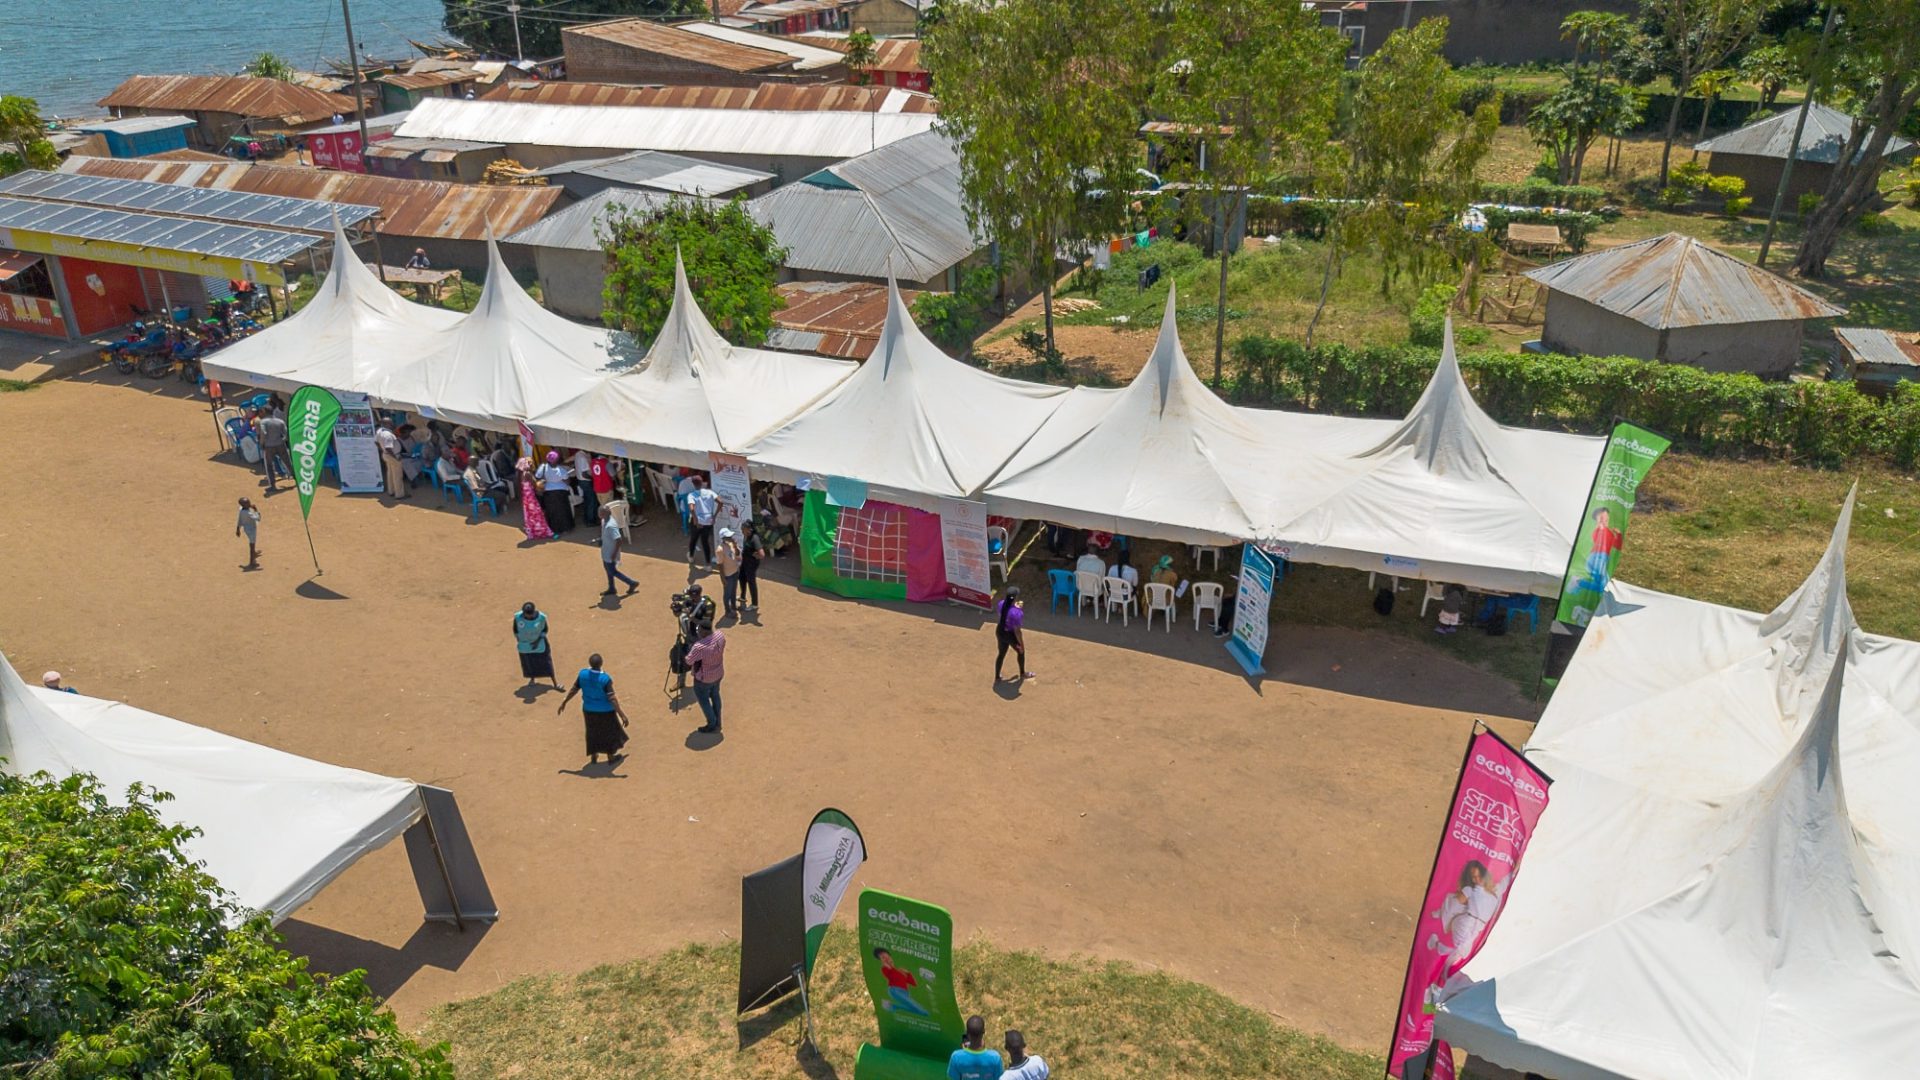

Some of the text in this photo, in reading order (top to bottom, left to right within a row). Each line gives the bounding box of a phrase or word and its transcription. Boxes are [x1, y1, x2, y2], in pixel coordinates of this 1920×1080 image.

[293, 400, 321, 495] ecobana
[1614, 437, 1658, 456] ecobana
[1601, 472, 1639, 493] FRES
[1476, 754, 1546, 800] ecobana
[1465, 788, 1520, 826] STAY
[1454, 821, 1484, 841] FEEL
[1459, 799, 1524, 850] FRESH
[1453, 830, 1515, 866] CONFIDEN
[868, 908, 939, 936] ecobana
[868, 928, 899, 945] STAY
[900, 935, 939, 957] FRESH
[868, 939, 938, 964] FEEL CONFIDENT
